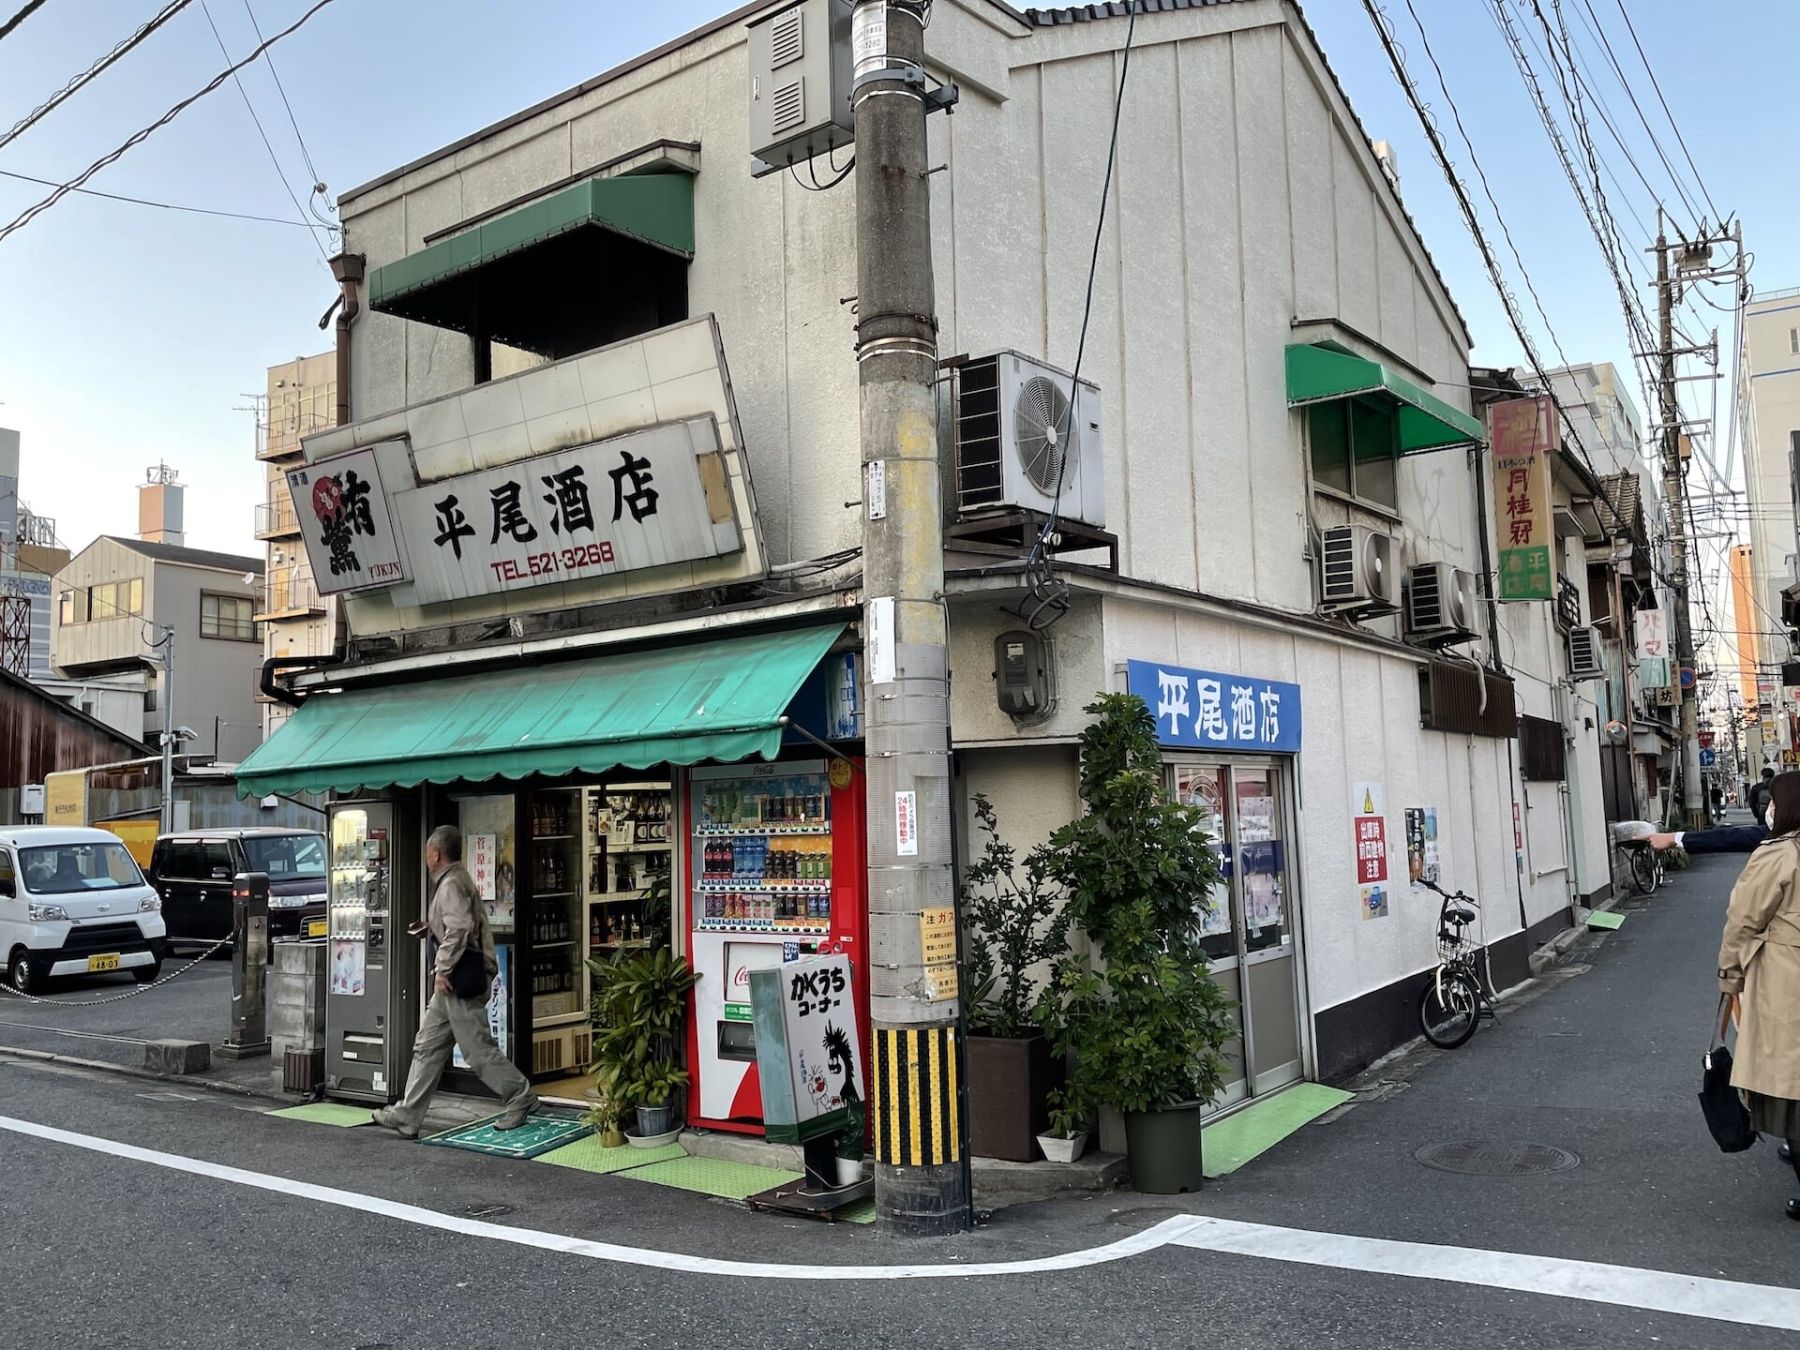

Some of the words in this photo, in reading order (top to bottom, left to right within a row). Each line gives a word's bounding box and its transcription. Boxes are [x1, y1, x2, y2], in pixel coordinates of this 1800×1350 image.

[433, 450, 660, 560] 平尾酒店
[1506, 468, 1534, 545] 月桂冠
[490, 541, 615, 582] TEL.521-3268
[1157, 669, 1281, 744] 平尾酒店
[791, 966, 846, 1002] かくうち
[798, 996, 841, 1019] コーナー
